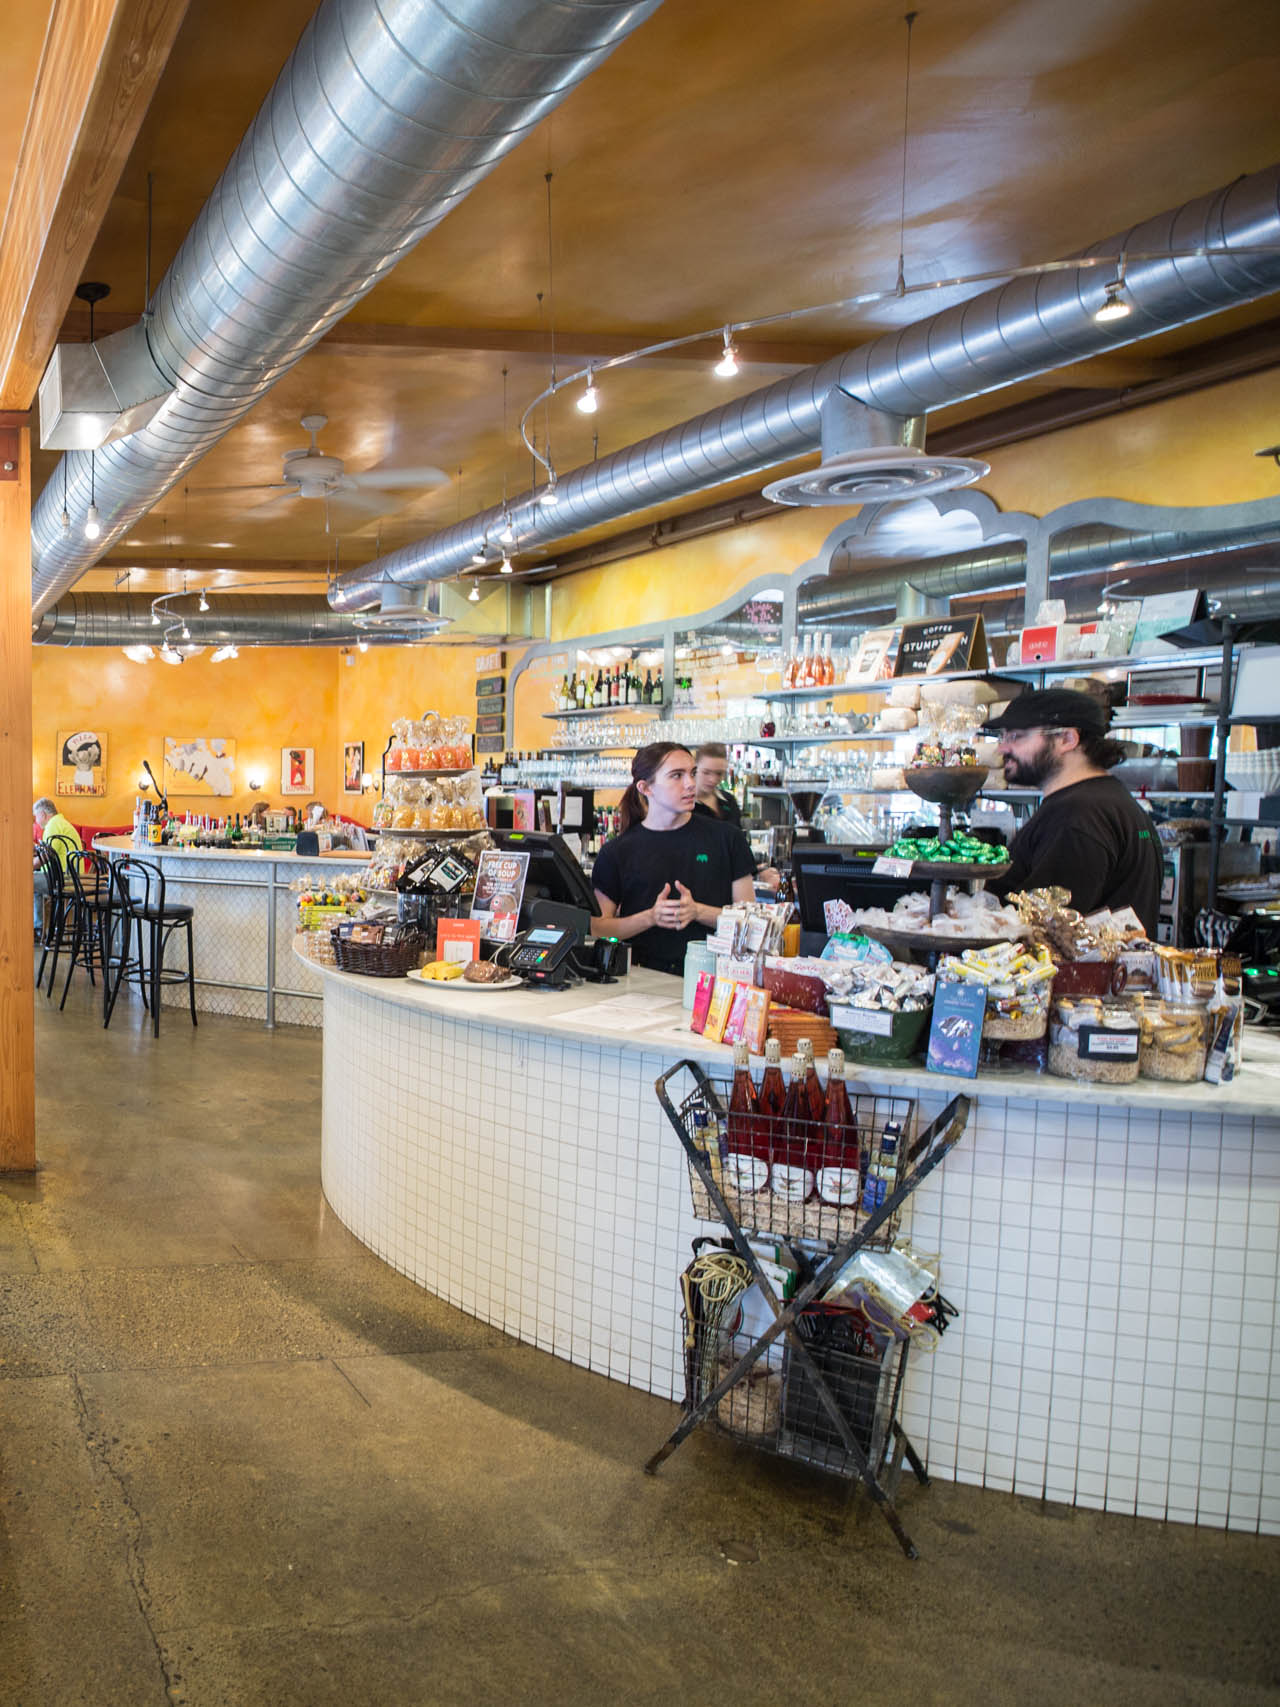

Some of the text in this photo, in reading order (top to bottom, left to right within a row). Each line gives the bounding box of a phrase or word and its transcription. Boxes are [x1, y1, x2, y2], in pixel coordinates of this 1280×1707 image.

[923, 624, 953, 636] COFFEE
[903, 635, 969, 653] STUMPN
[504, 861, 518, 870] CUP
[497, 869, 516, 878] SOUP
